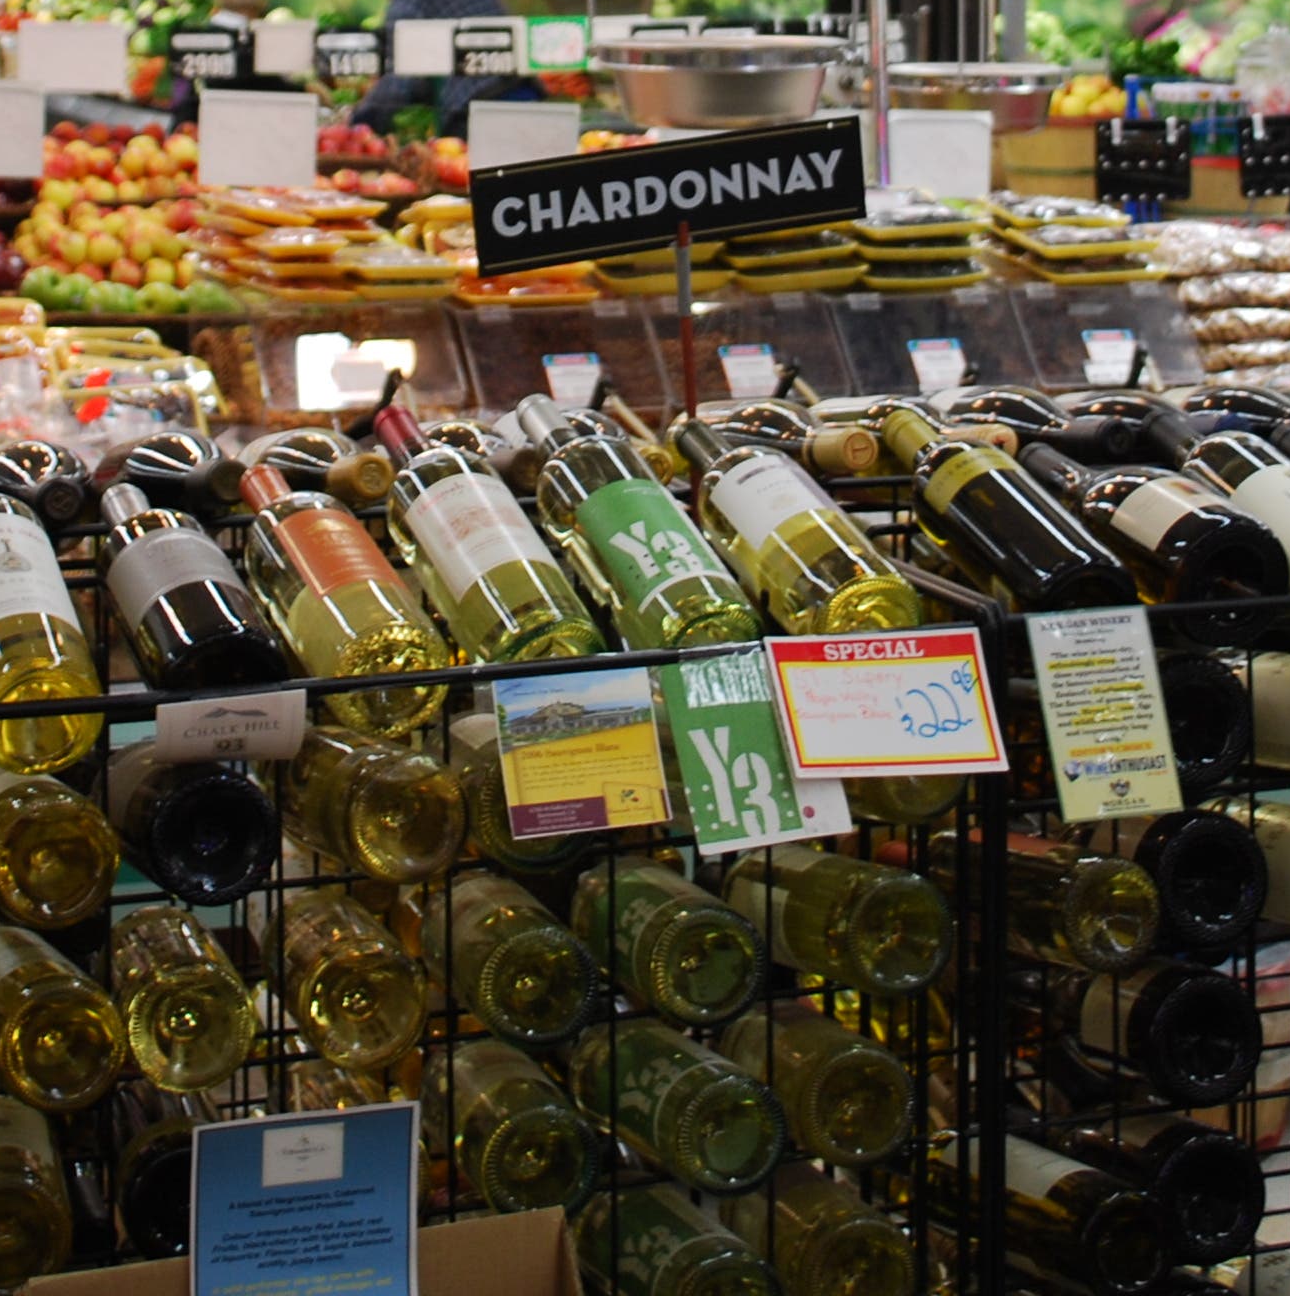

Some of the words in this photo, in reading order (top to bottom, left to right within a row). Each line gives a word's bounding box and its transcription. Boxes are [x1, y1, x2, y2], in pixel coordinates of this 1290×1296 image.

[491, 148, 843, 238] CHARDONNAY
[823, 639, 925, 661] SPECIAL
[183, 725, 239, 739] CHALK
[244, 719, 282, 732] HILL
[216, 741, 244, 752] 93
[687, 725, 781, 842] Y3
